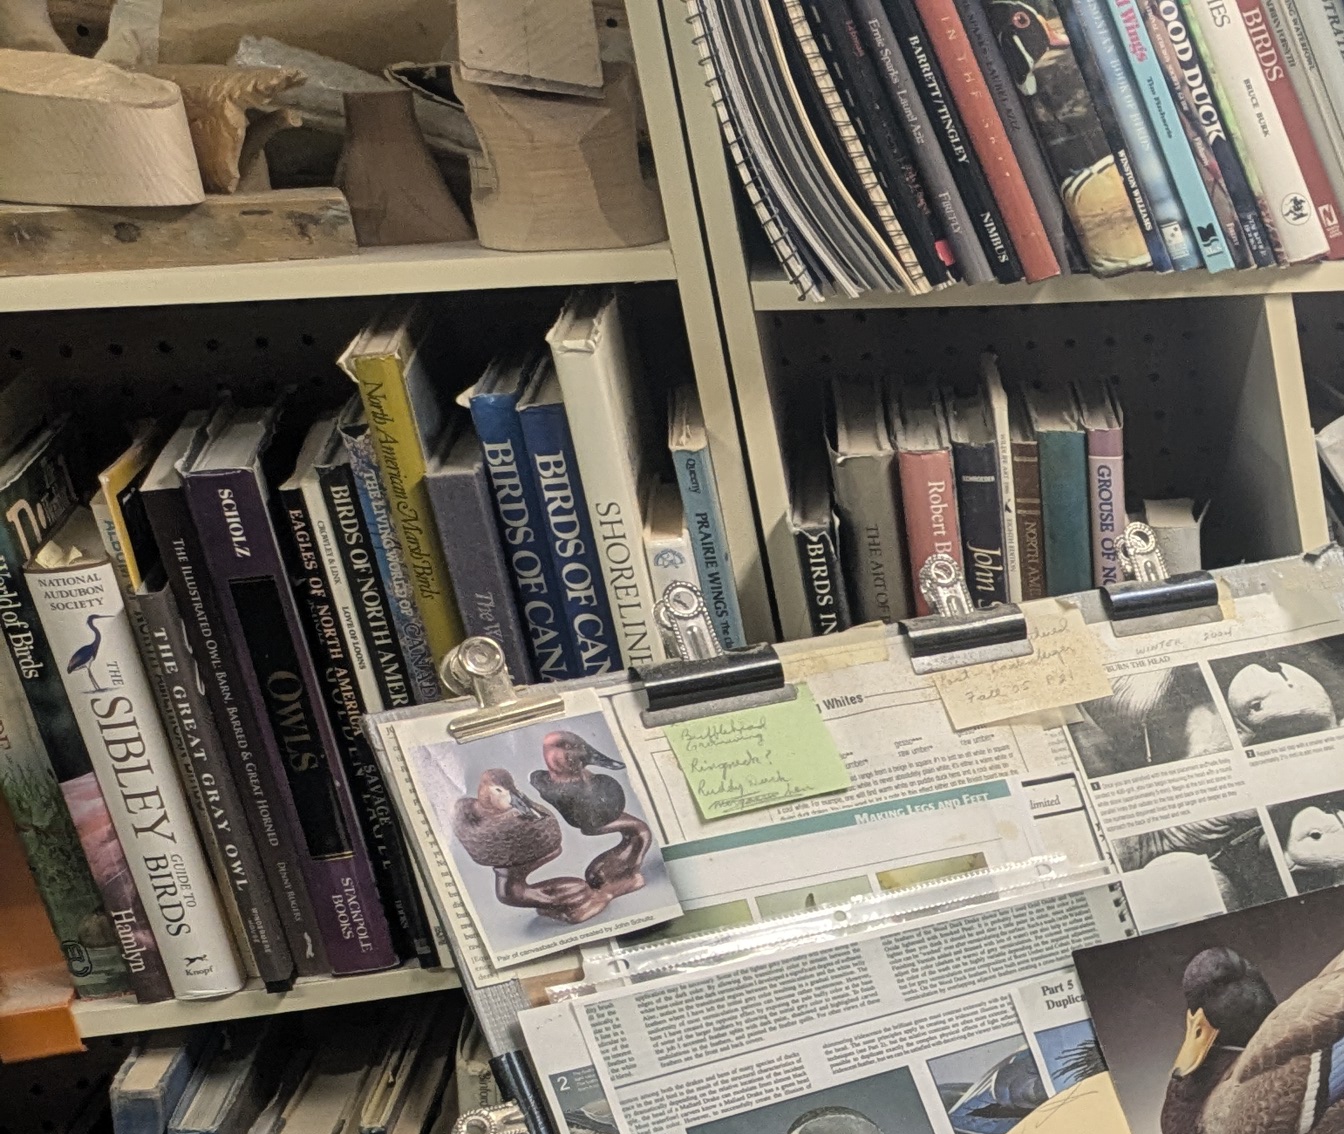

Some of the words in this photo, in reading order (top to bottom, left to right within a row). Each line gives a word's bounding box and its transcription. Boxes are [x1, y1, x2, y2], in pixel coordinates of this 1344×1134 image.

[1243, 6, 1284, 82] BIRDS
[908, 35, 941, 97] BARRETT
[937, 105, 969, 164] TINGLEY
[1183, 67, 1227, 145] DUCK
[1243, 78, 1257, 108] BRUCE
[1255, 112, 1271, 138] BURK
[1118, 149, 1136, 189] WINSTON
[1131, 189, 1152, 231] WILLIAMS
[979, 211, 1009, 263] NIMBUS
[363, 381, 394, 425] North
[217, 488, 251, 558] SCHOLZ
[330, 485, 363, 545] BIRDS
[483, 438, 535, 546] BIRDS
[512, 550, 549, 596] OF
[927, 479, 949, 536] Robert
[1097, 464, 1115, 533] GROUSE
[534, 450, 585, 558] BIRDS
[561, 561, 598, 608] OF
[695, 512, 719, 567] PRAIRIE
[866, 523, 881, 558] THE
[38, 573, 103, 589] NATIONAL
[288, 509, 318, 570] EAGLES
[309, 577, 325, 599] OF
[317, 604, 343, 660] NORTH
[351, 547, 372, 576] OF
[596, 501, 655, 667] SHORELINE
[805, 543, 833, 606] BIRDS
[870, 561, 886, 592] ART
[966, 540, 1004, 592] John
[43, 585, 105, 600] AUDUBON
[50, 598, 104, 612] SOCIETY
[357, 577, 392, 647] NORTH
[705, 568, 728, 619] WINGS
[877, 591, 890, 612] OF
[10, 626, 43, 680] Birds
[342, 606, 353, 629] LOVE
[352, 641, 366, 671] LOONS
[1129, 658, 1146, 668] THE
[1146, 655, 1171, 666] HEAD
[1136, 638, 1184, 655] WINTER
[106, 660, 125, 686] THE
[172, 538, 186, 562] THE
[181, 565, 212, 638] ILLUSTRATED
[226, 706, 248, 749] BARRED
[244, 762, 264, 803] GREAT
[254, 800, 280, 847] HORNED
[266, 669, 320, 773] OWLS
[823, 693, 864, 713] Whites
[91, 696, 178, 844] SIBLEY
[153, 627, 179, 674] THE
[173, 686, 208, 762] GREAT
[201, 773, 231, 833] GRAY
[225, 844, 249, 892] OWL
[361, 763, 392, 825] SAVAGE
[854, 805, 904, 824] MAKING
[906, 800, 938, 816] LEGS
[938, 797, 961, 810] AND
[962, 791, 989, 806] FEET
[1029, 795, 1061, 810] limited
[143, 853, 192, 938] BIRDS
[170, 853, 192, 891] GUIDE
[183, 892, 197, 908] TO
[111, 908, 146, 973] Hamlyn
[331, 893, 353, 941] BOOKS
[341, 877, 373, 953] STACKPOLE
[497, 954, 511, 962] Pair
[519, 942, 558, 957] canvasback
[559, 936, 579, 945] ducks
[579, 929, 605, 940] created
[614, 920, 630, 930] John
[185, 965, 214, 977] Knopf
[1041, 983, 1064, 997] Part
[1066, 979, 1075, 990] 5
[557, 1076, 571, 1092] 2
